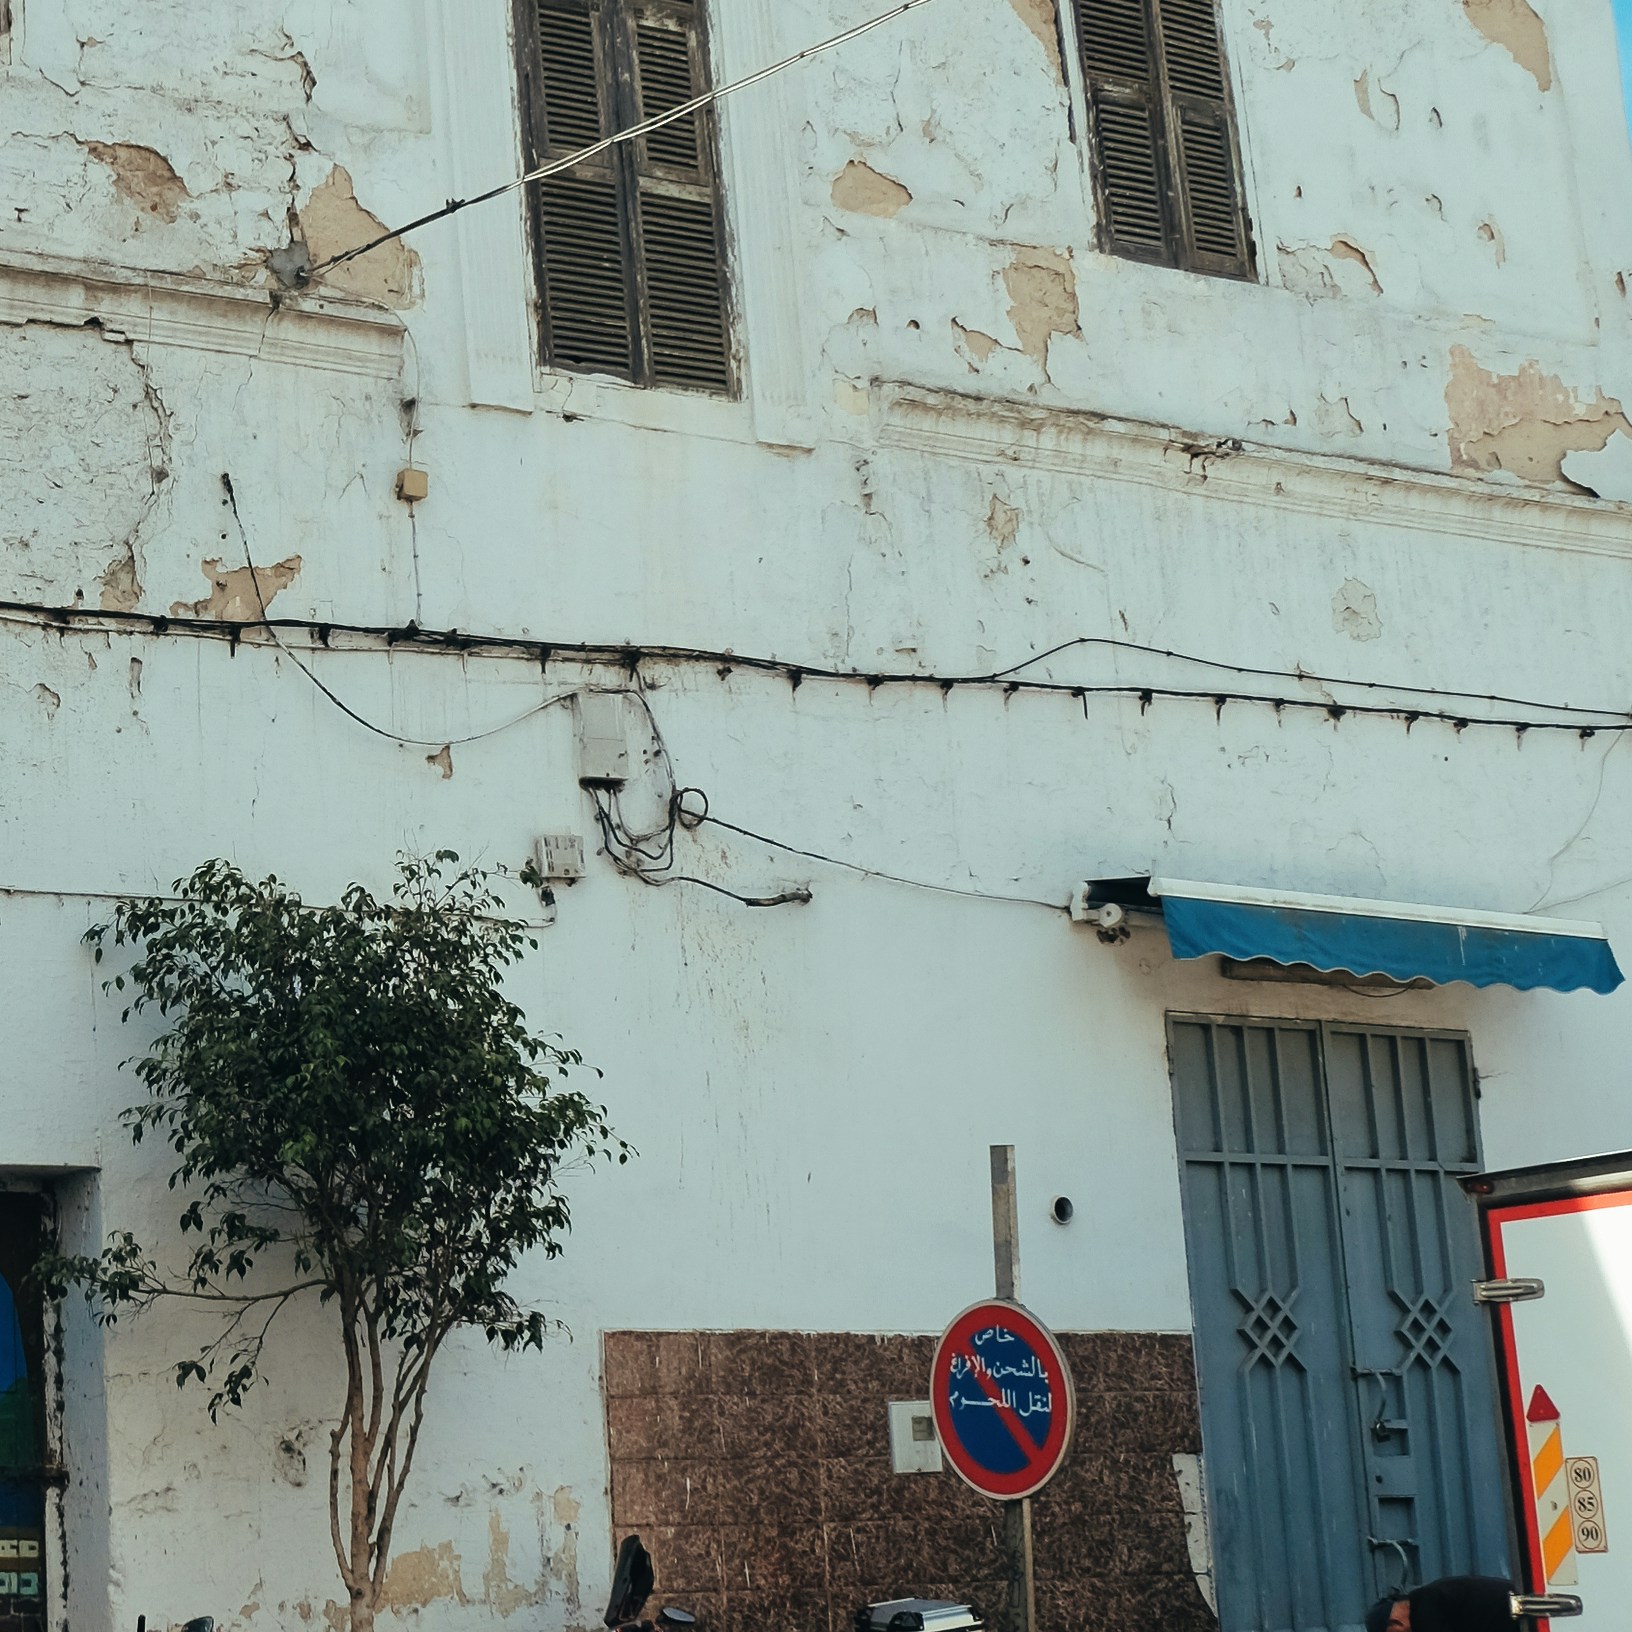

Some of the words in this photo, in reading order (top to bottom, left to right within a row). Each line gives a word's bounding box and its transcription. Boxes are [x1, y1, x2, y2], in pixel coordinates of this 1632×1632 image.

[975, 1324, 1015, 1345] خاص
[993, 1355, 1049, 1384] بالشحن
[1019, 1391, 1052, 1417] لنقل
[1574, 1467, 1592, 1483] 80
[1577, 1496, 1595, 1512] 85
[1581, 1526, 1599, 1542] 90
